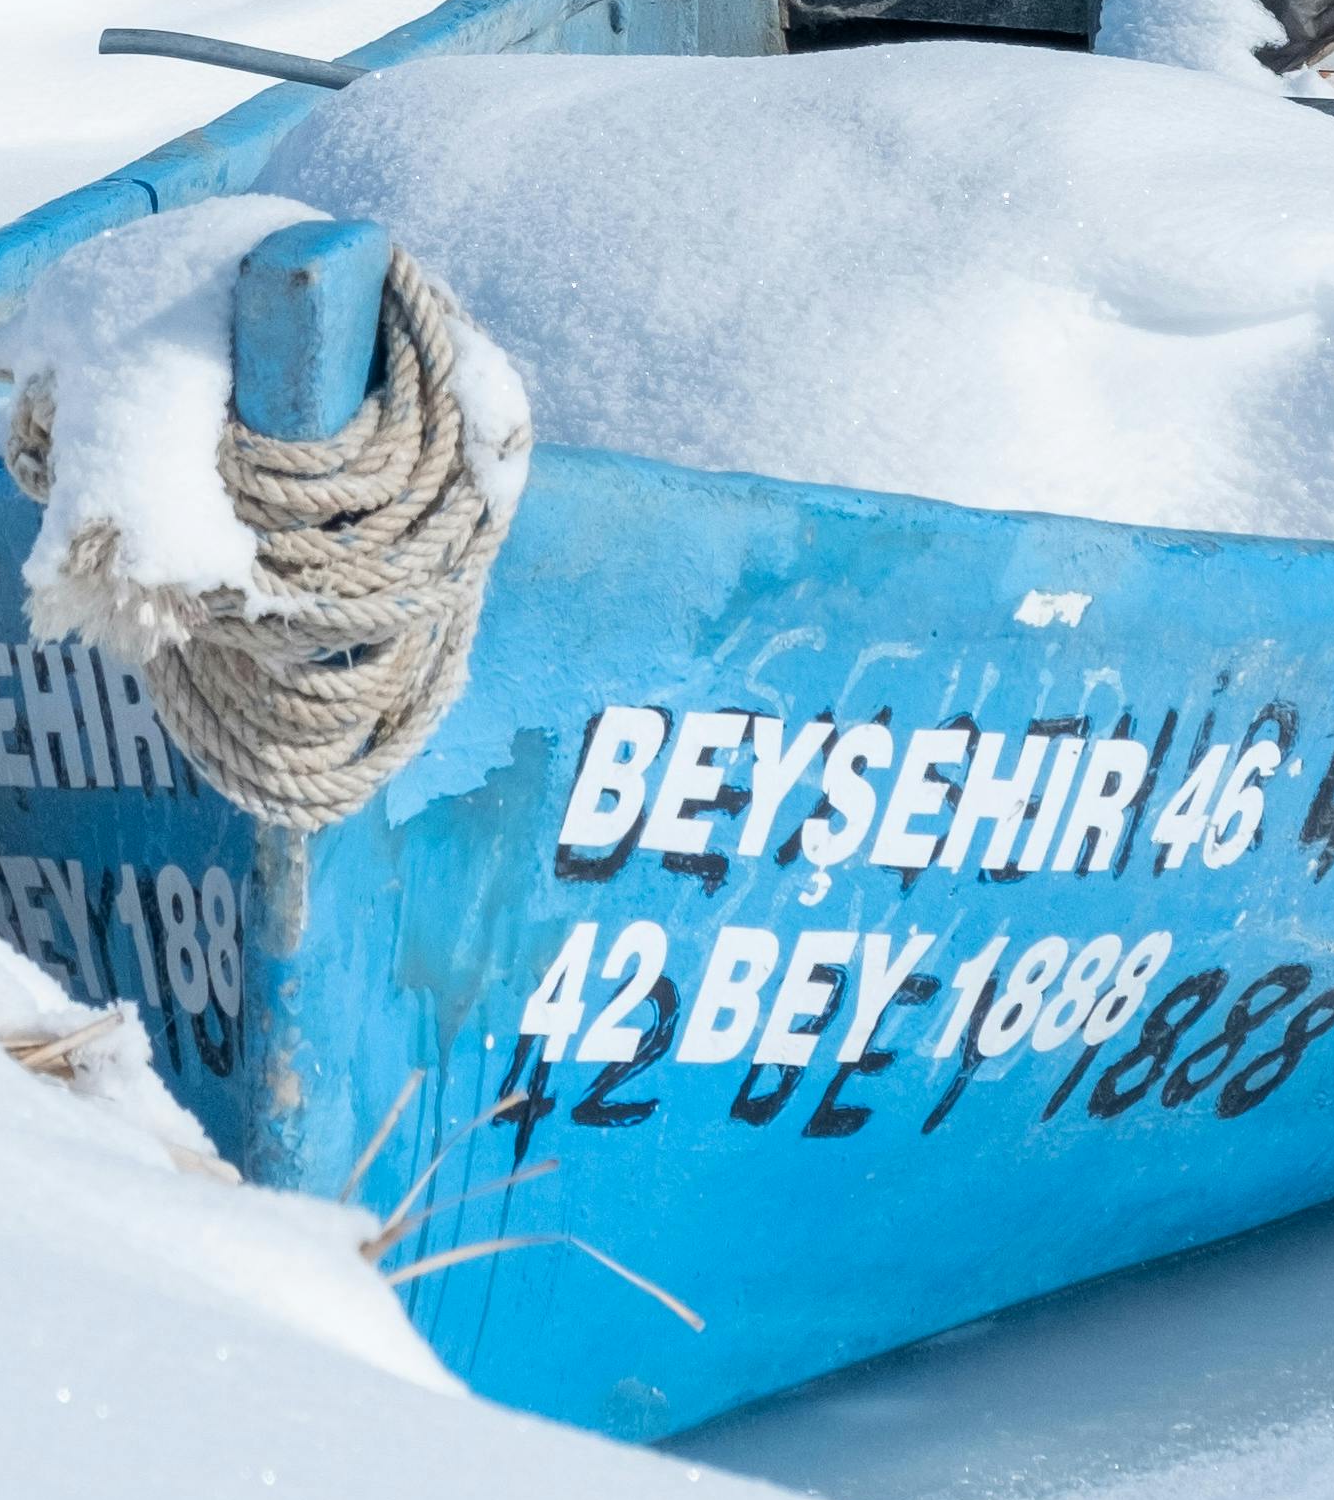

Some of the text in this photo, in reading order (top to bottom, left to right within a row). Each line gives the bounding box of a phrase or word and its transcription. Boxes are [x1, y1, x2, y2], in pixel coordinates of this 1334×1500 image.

[1152, 740, 1281, 870] 46
[120, 863, 249, 1018] 188
[520, 920, 1173, 1066] 42 BEY 1888
